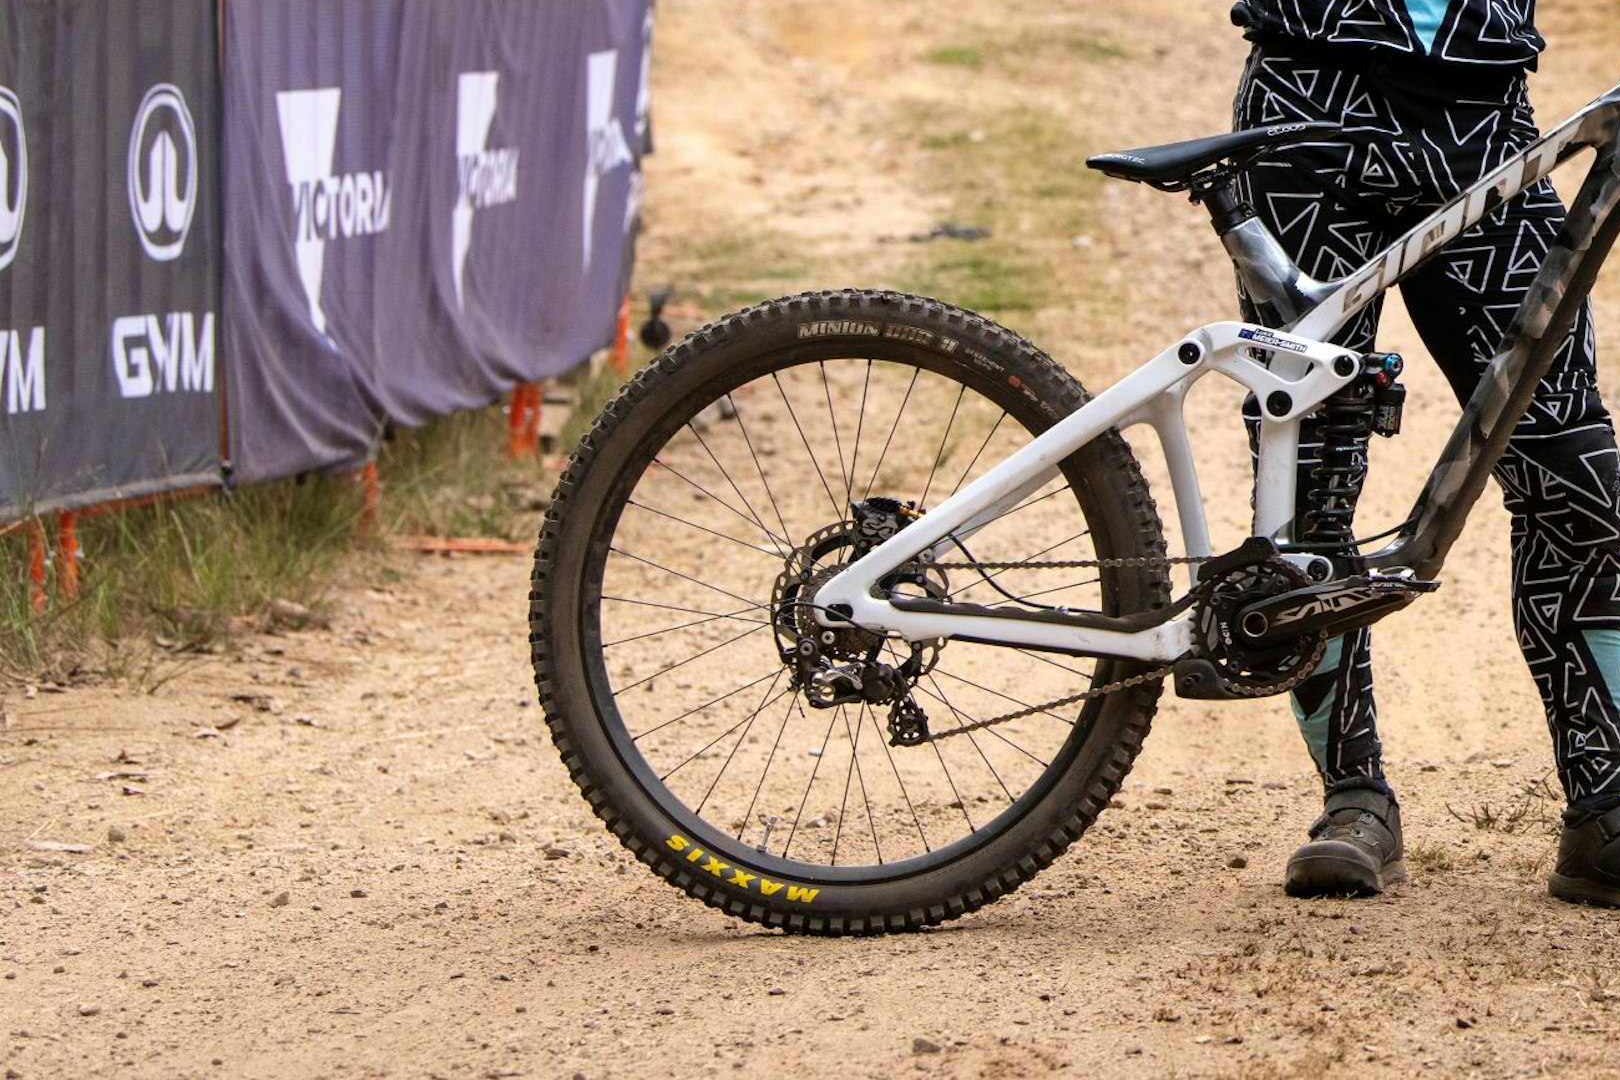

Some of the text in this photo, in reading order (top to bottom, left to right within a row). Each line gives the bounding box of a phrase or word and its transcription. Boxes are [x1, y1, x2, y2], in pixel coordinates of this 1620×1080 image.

[111, 311, 216, 399] GWM
[797, 320, 880, 339] MINION
[664, 832, 821, 904] MAXXIS
